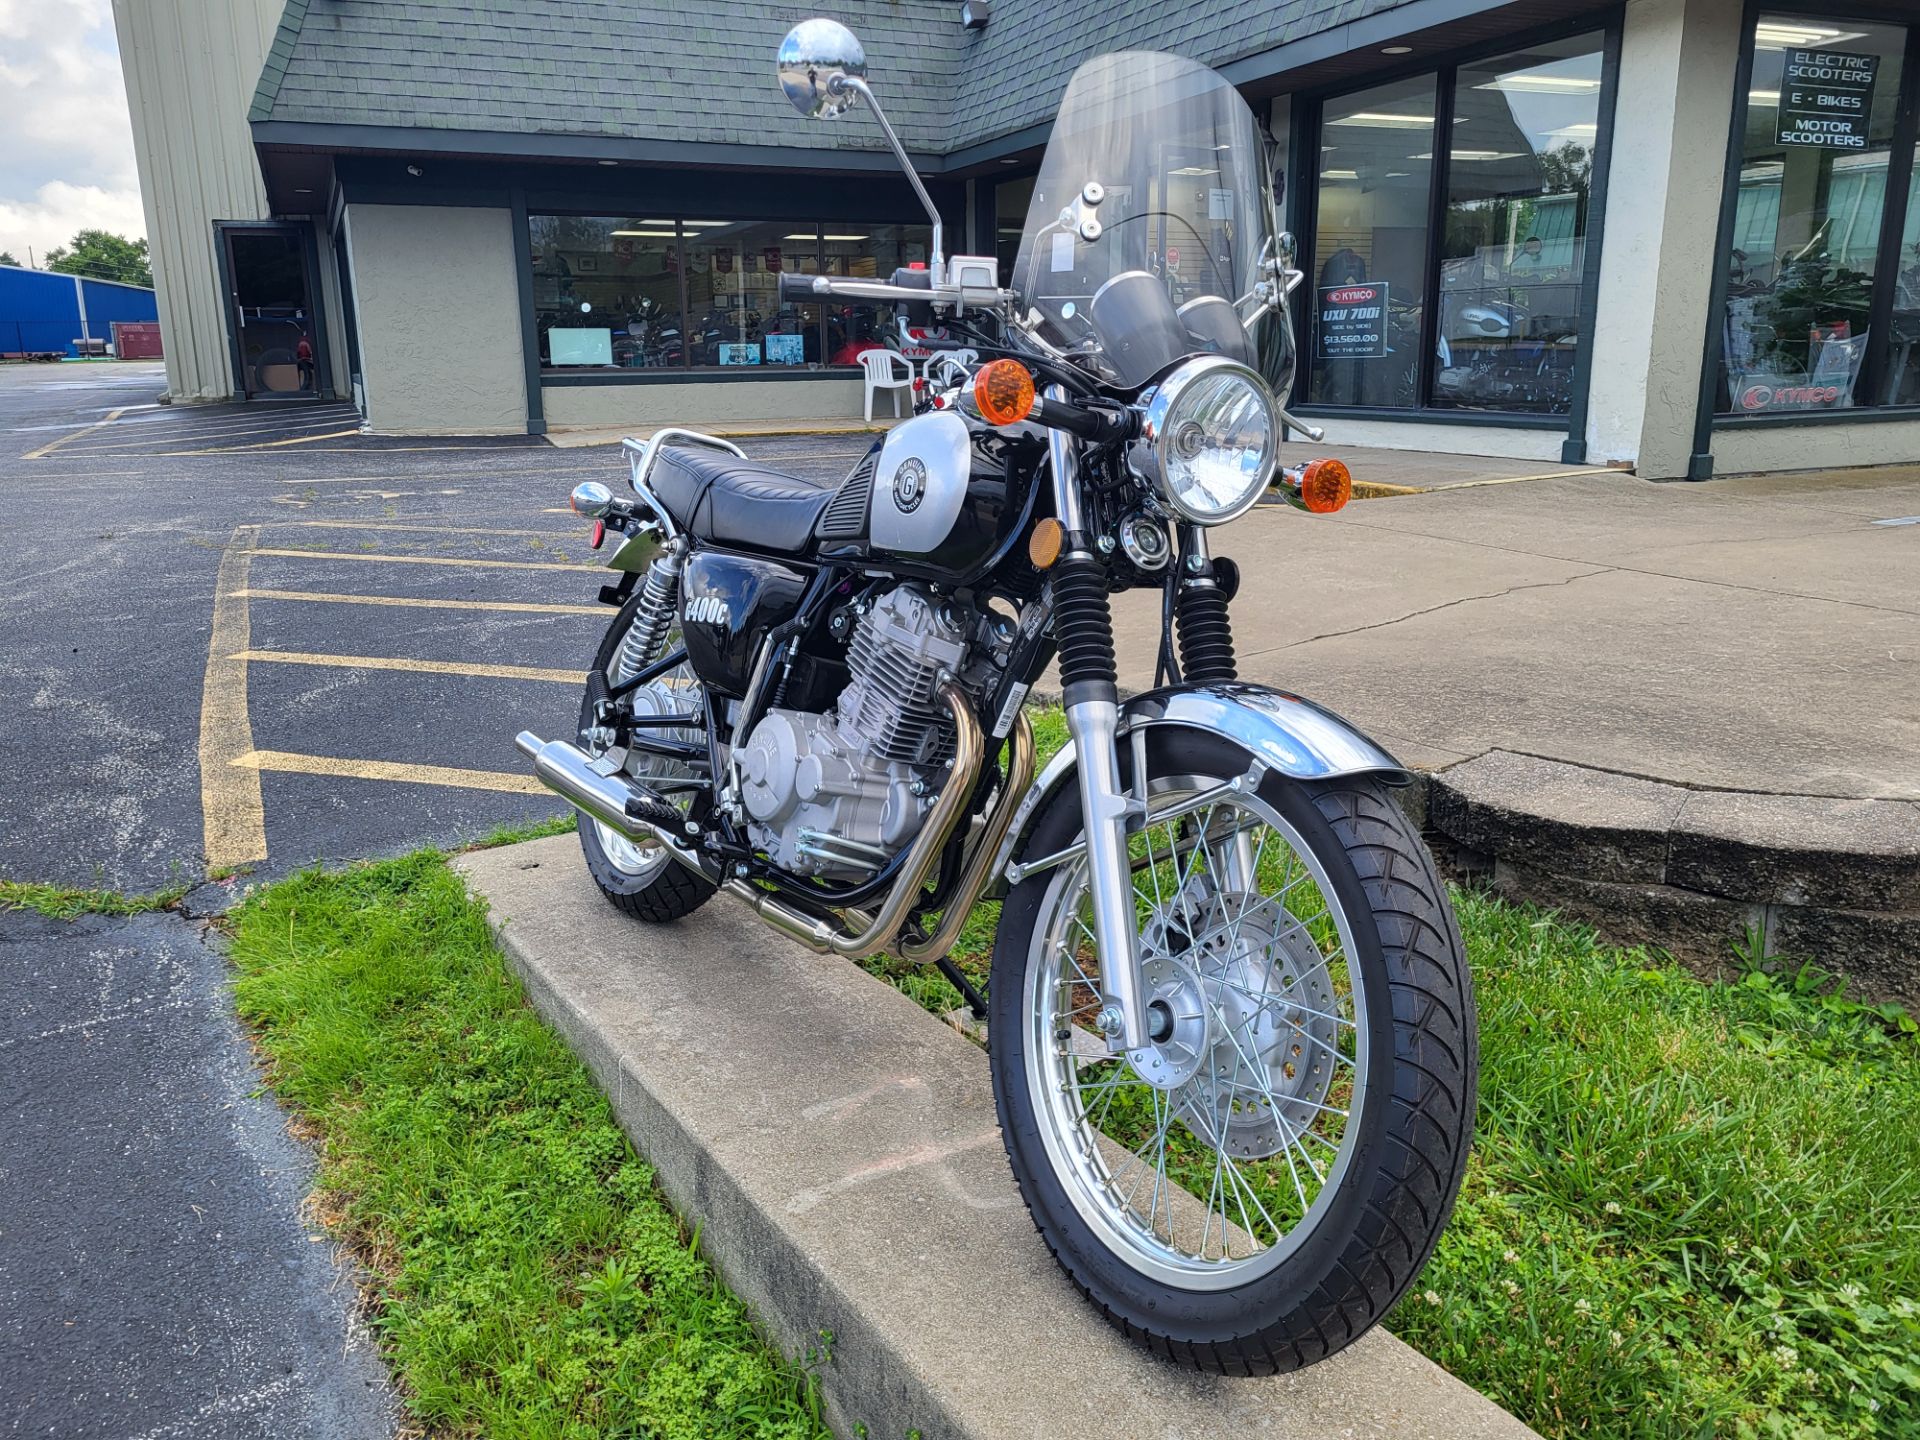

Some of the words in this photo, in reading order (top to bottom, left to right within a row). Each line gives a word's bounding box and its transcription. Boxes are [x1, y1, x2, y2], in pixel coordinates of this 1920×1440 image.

[1794, 52, 1870, 69] ELECTRIC
[1788, 65, 1872, 83] SCOOTERS
[1817, 94, 1862, 108] BIKES
[1795, 119, 1852, 133] MOTOR
[1781, 131, 1864, 147] SCOOTERS
[1342, 291, 1372, 300] KYMCO
[1323, 309, 1348, 321] UXV
[1350, 307, 1380, 320] 700i
[901, 347, 933, 356] KYM
[1773, 386, 1838, 404] KYMCO
[899, 459, 925, 479] GENUINE
[903, 476, 913, 495] G
